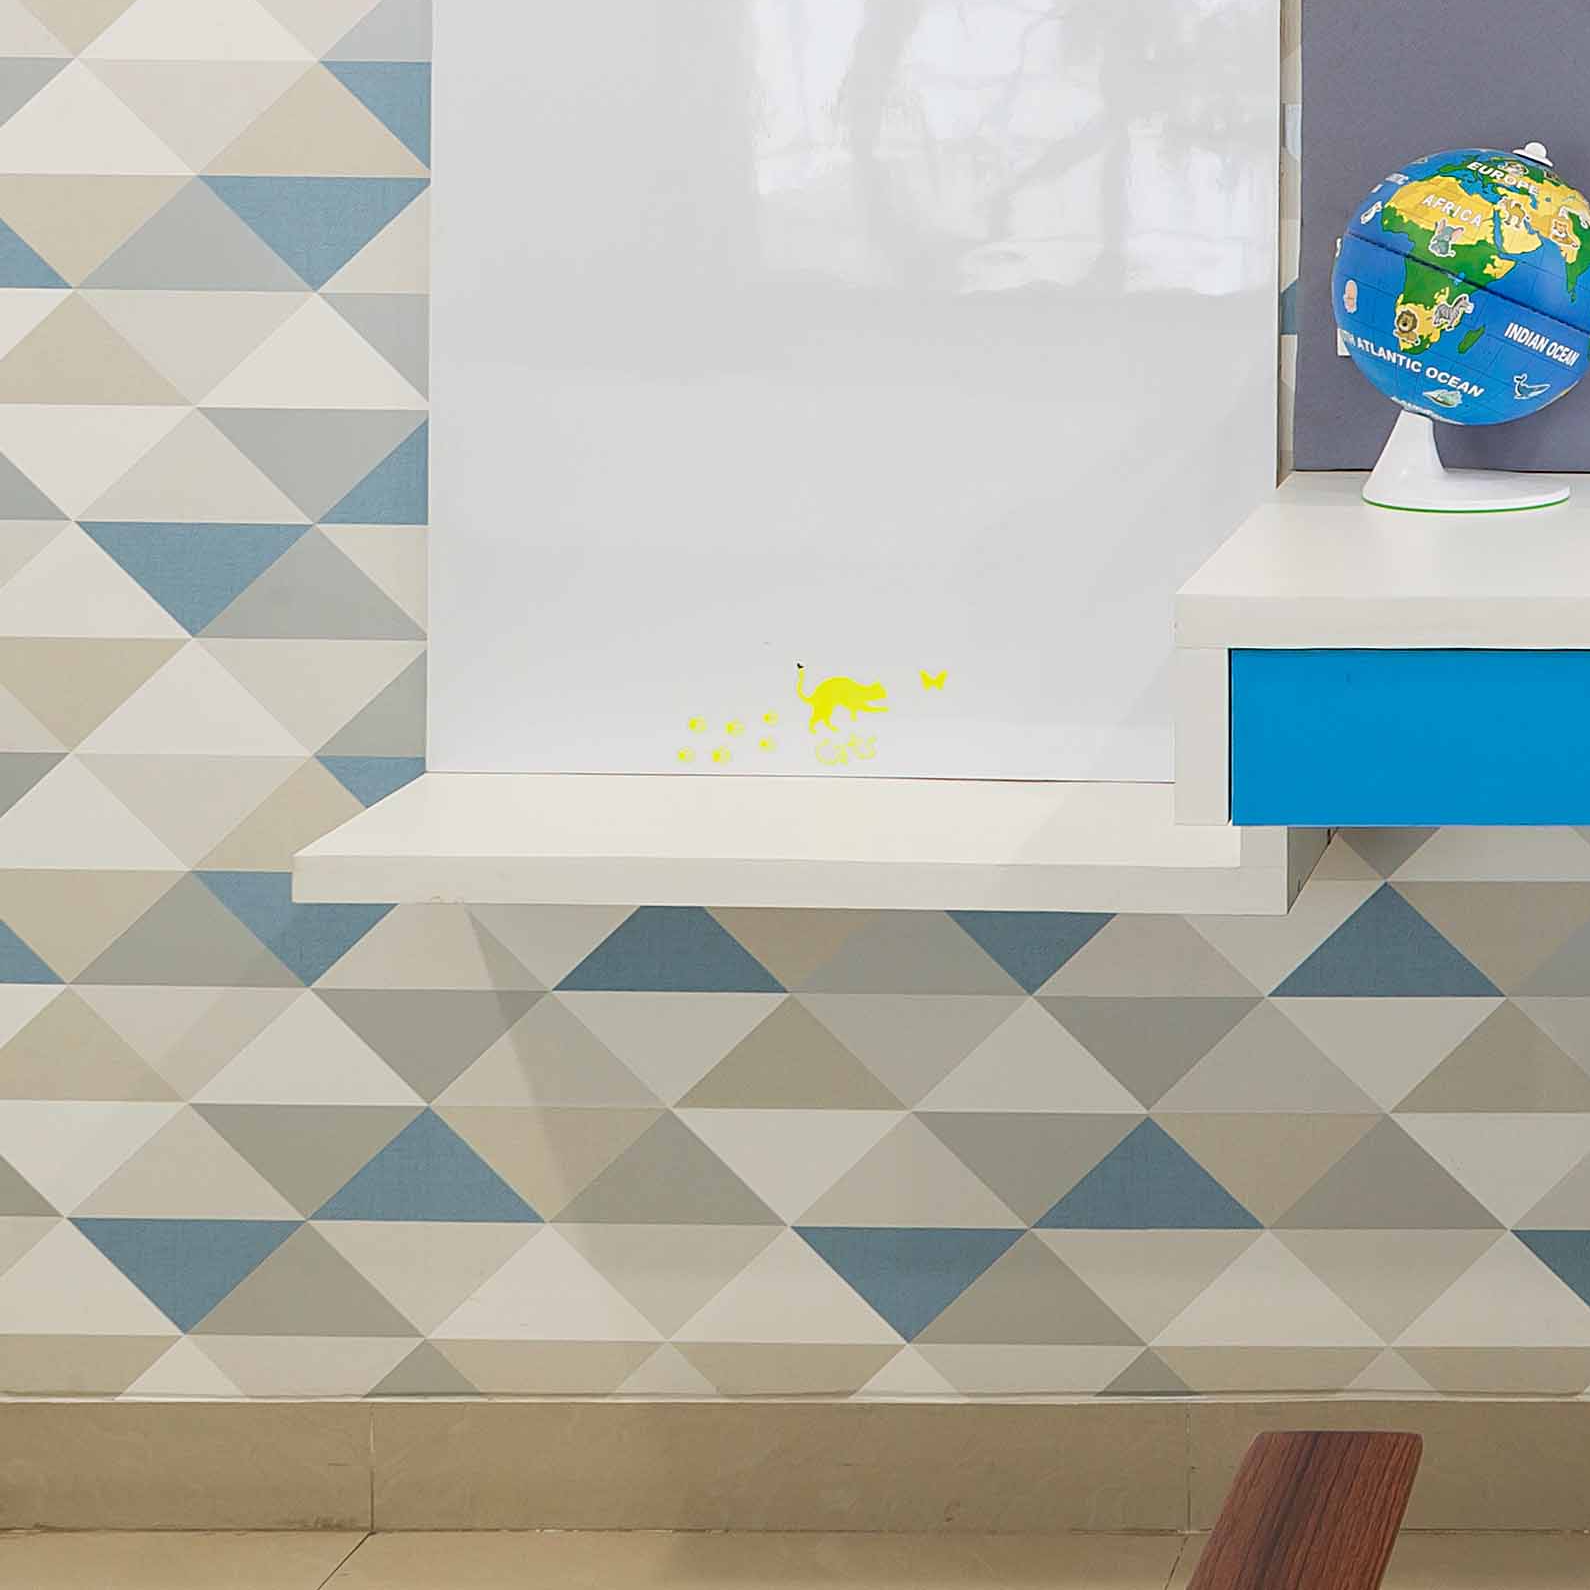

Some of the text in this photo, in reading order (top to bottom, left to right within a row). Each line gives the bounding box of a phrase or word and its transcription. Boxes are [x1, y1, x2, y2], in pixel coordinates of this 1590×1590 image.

[1466, 161, 1539, 196] EUROPE
[1422, 194, 1483, 227] AFRICA
[1504, 322, 1580, 368] INDIAN OCEAN
[1356, 338, 1423, 372] ATLANTIC
[1425, 366, 1485, 397] OCEAN
